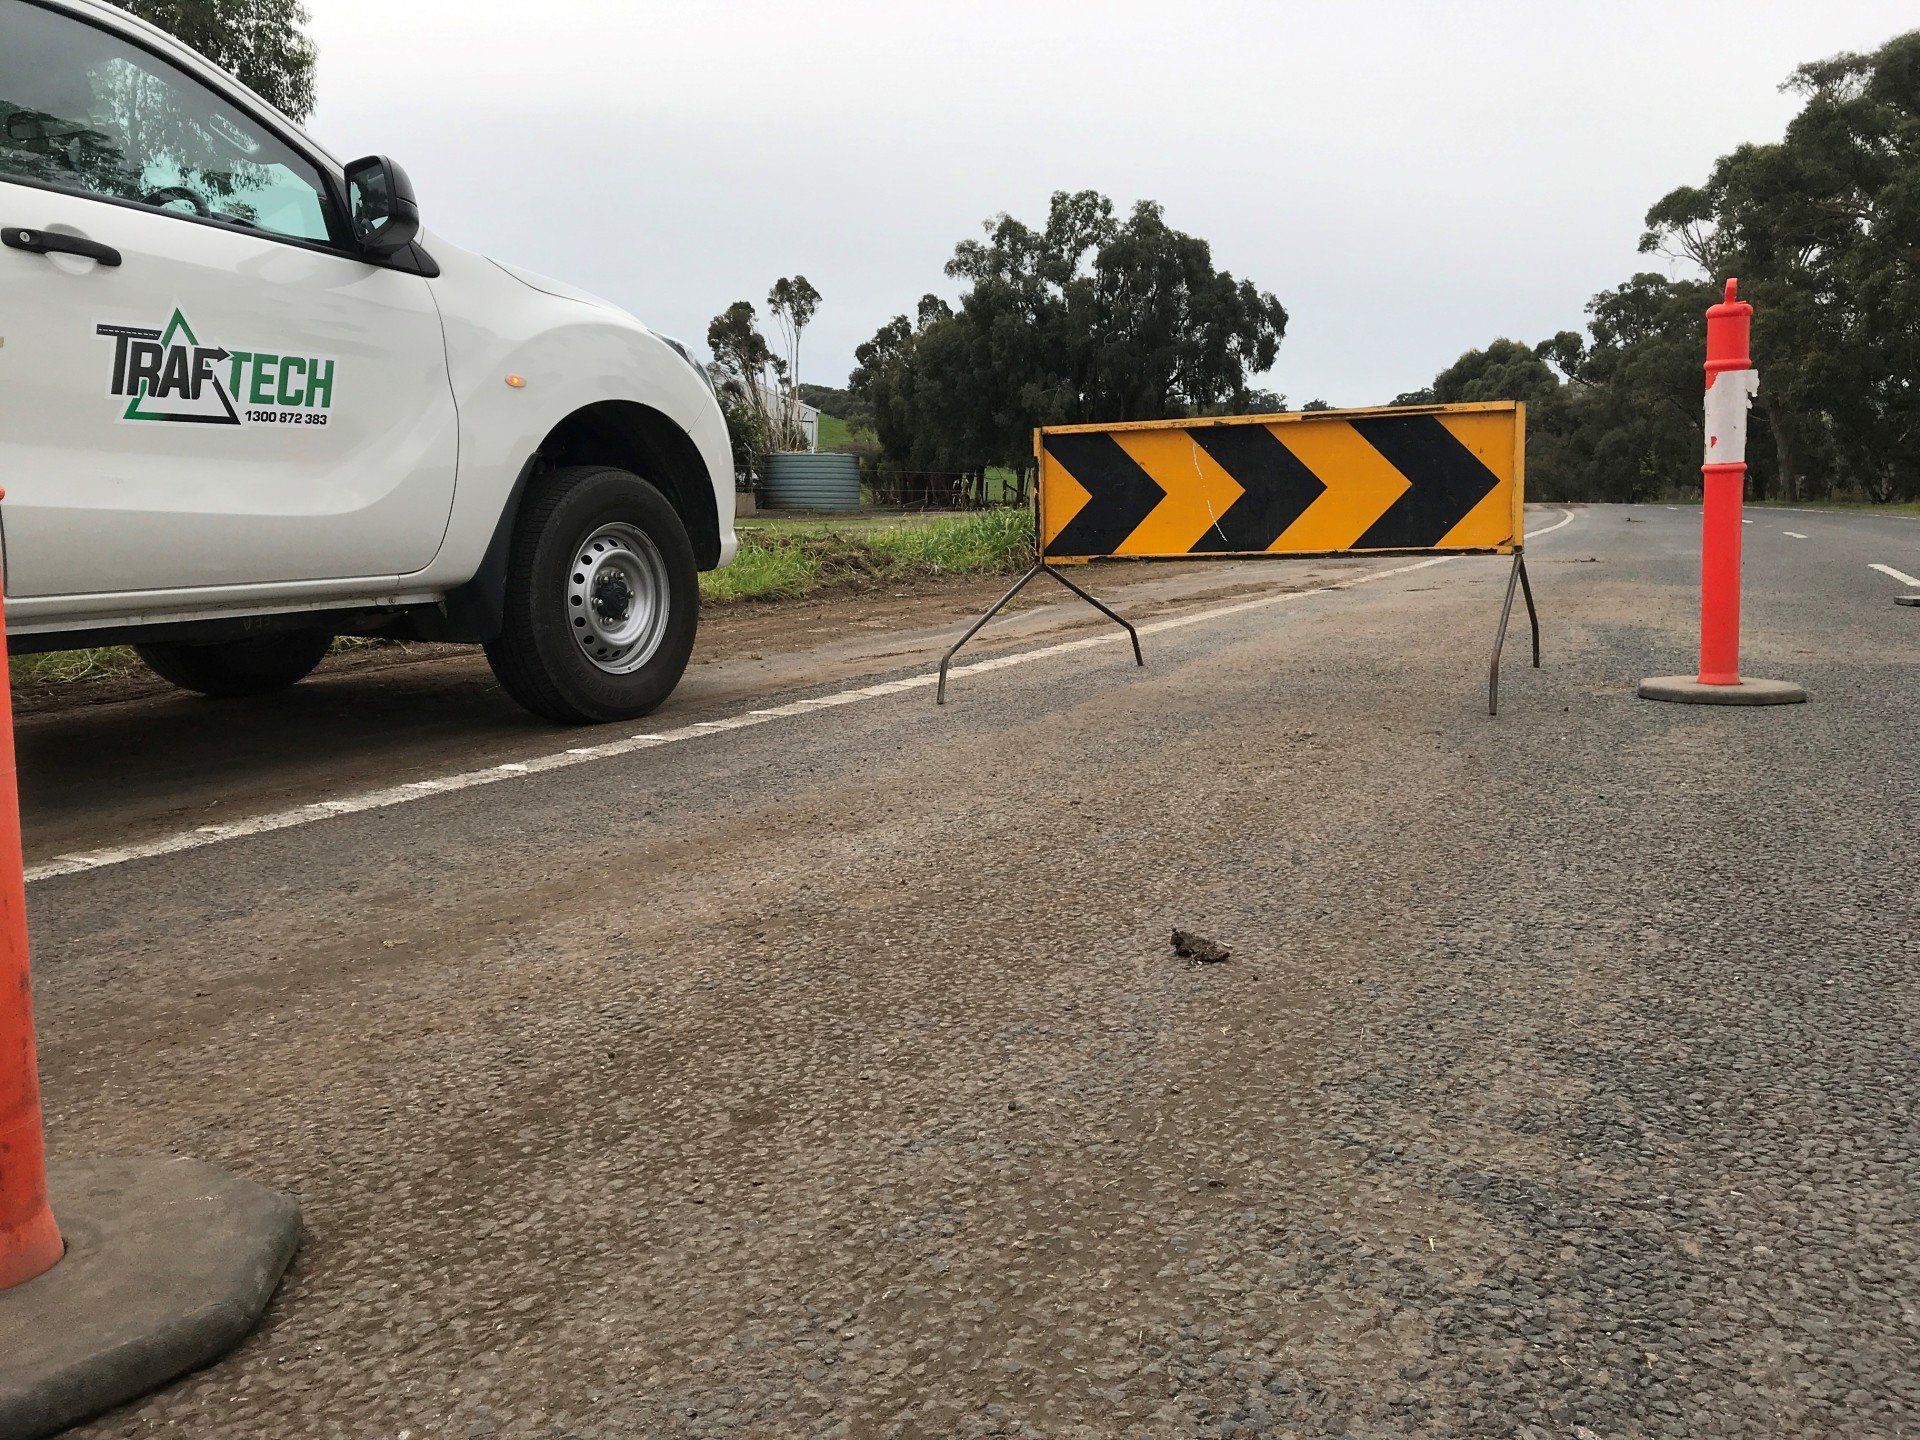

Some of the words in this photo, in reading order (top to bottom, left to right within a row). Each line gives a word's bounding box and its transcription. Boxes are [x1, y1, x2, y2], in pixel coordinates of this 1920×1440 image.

[245, 410, 277, 423] 1300
[279, 412, 302, 424] 872
[304, 414, 328, 425] 383
